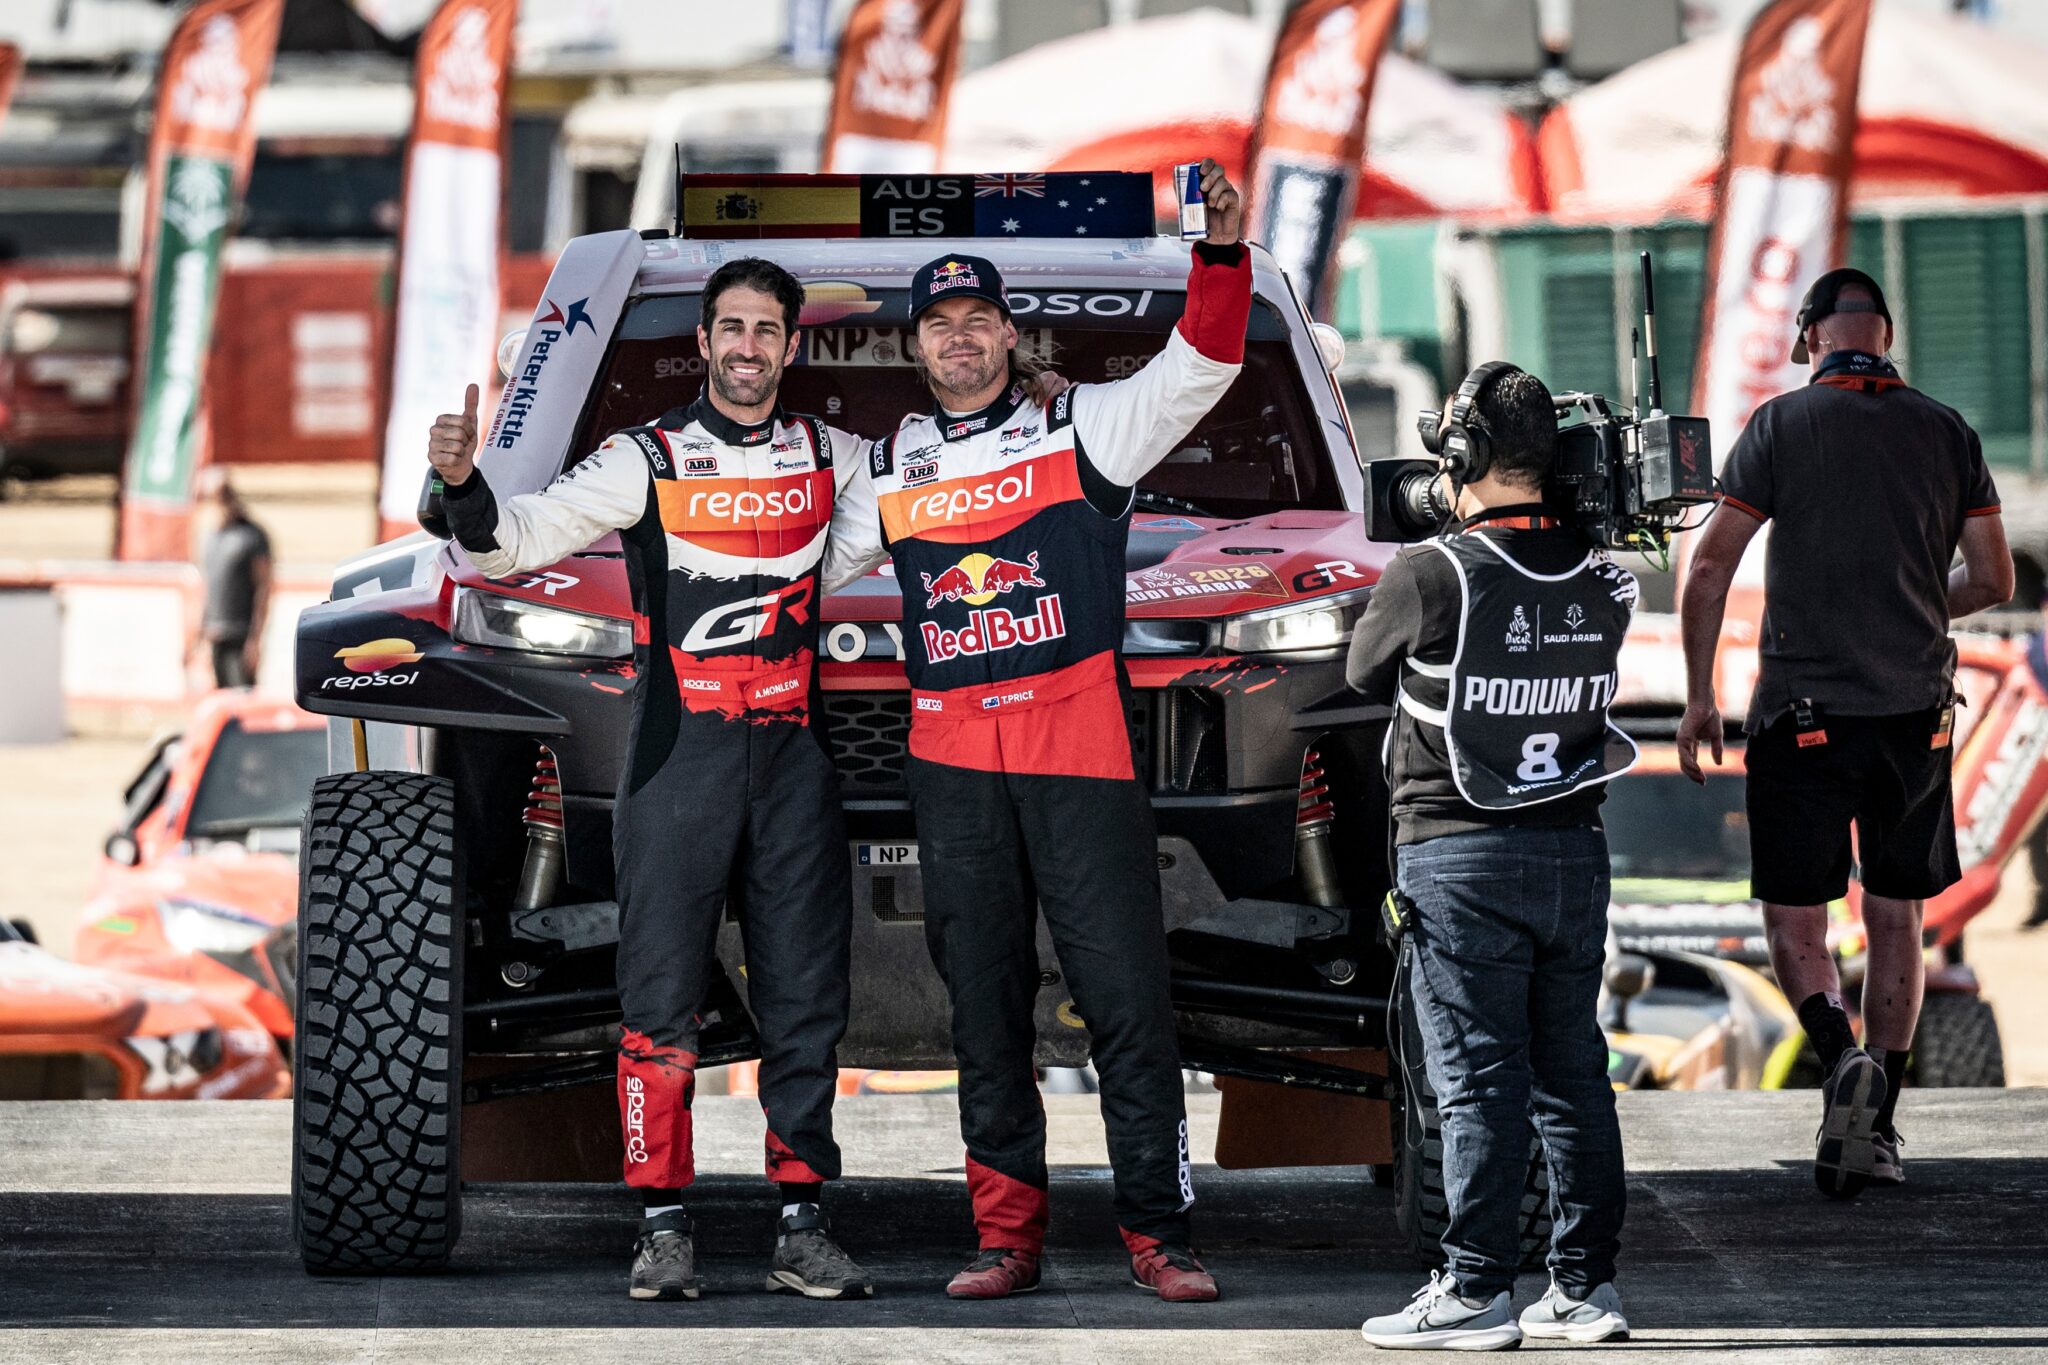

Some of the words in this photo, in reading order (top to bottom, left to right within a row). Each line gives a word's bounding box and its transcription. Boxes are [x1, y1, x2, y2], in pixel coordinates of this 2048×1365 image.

[872, 179, 962, 199] AUS
[889, 207, 945, 235] ES
[930, 277, 953, 295] Red
[955, 275, 980, 287] Bull
[521, 329, 562, 386] Peter
[501, 376, 518, 404] MOTOR
[486, 409, 506, 447] COMPANY
[496, 388, 538, 449] Kittle
[950, 427, 967, 437] GR
[635, 433, 667, 472] sparco
[689, 460, 715, 470] ARB
[907, 465, 934, 480] ARB
[688, 478, 812, 524] repsol
[910, 464, 1033, 521] repsol
[1188, 565, 1270, 584] 2026
[1292, 560, 1365, 594] GR
[1126, 588, 1169, 604] AUDI
[1171, 579, 1252, 597] ARABIA
[680, 574, 815, 653] GR
[919, 609, 988, 665] Red
[982, 593, 1066, 651] Bull
[1543, 634, 1570, 644] SAUDI
[1571, 633, 1603, 643] ARABIA
[320, 671, 420, 690] repsol
[683, 678, 721, 691] sparco
[1463, 675, 1584, 716] PODIUM
[1588, 670, 1616, 712] TV
[916, 697, 943, 712] sparco
[1001, 690, 1035, 705] T.PRICE
[1516, 732, 1563, 782] 8
[879, 846, 909, 863] NP
[626, 1075, 649, 1164] sparco
